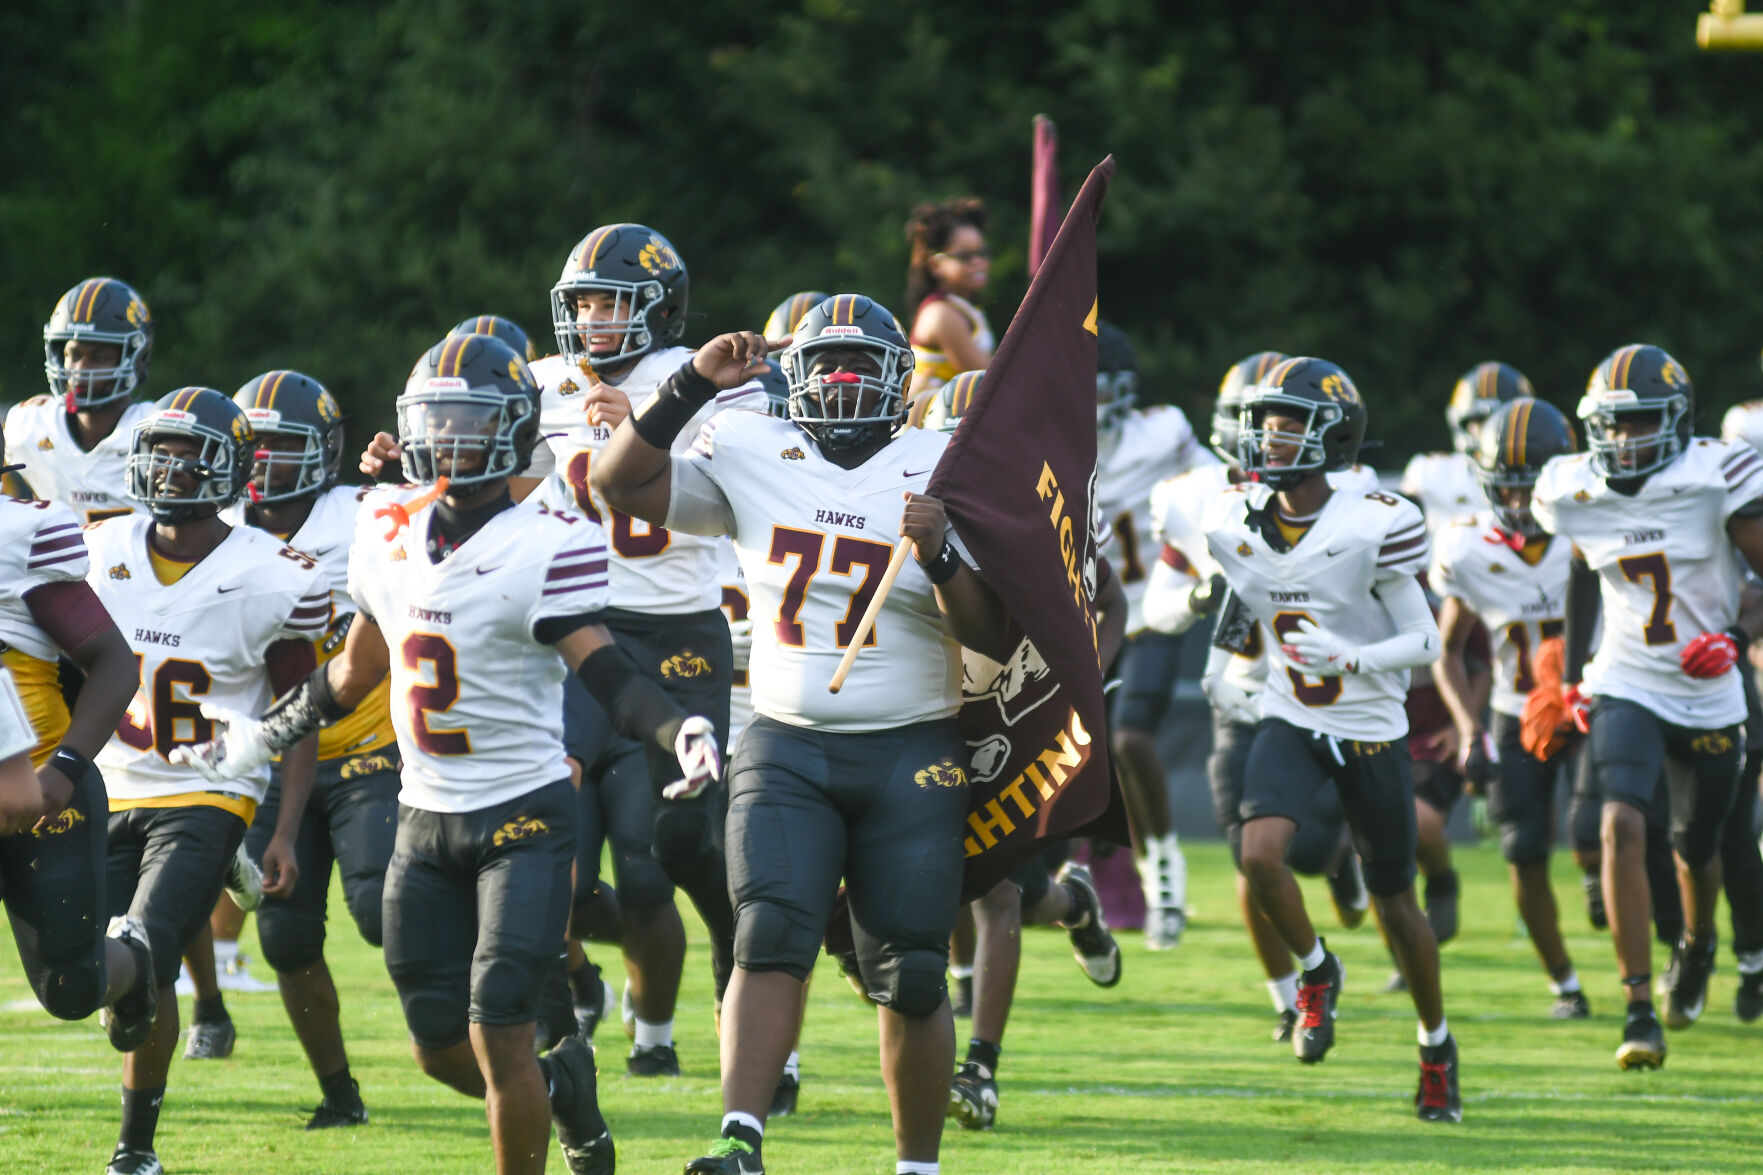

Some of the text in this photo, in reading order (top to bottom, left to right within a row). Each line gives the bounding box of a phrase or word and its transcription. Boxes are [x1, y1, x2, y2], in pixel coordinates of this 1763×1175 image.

[815, 509, 865, 530] HAWKS
[409, 604, 453, 625] HAWKS
[766, 524, 894, 649] 77
[1618, 551, 1677, 646] 7
[134, 628, 181, 648] HAWKS
[402, 630, 474, 757] 2
